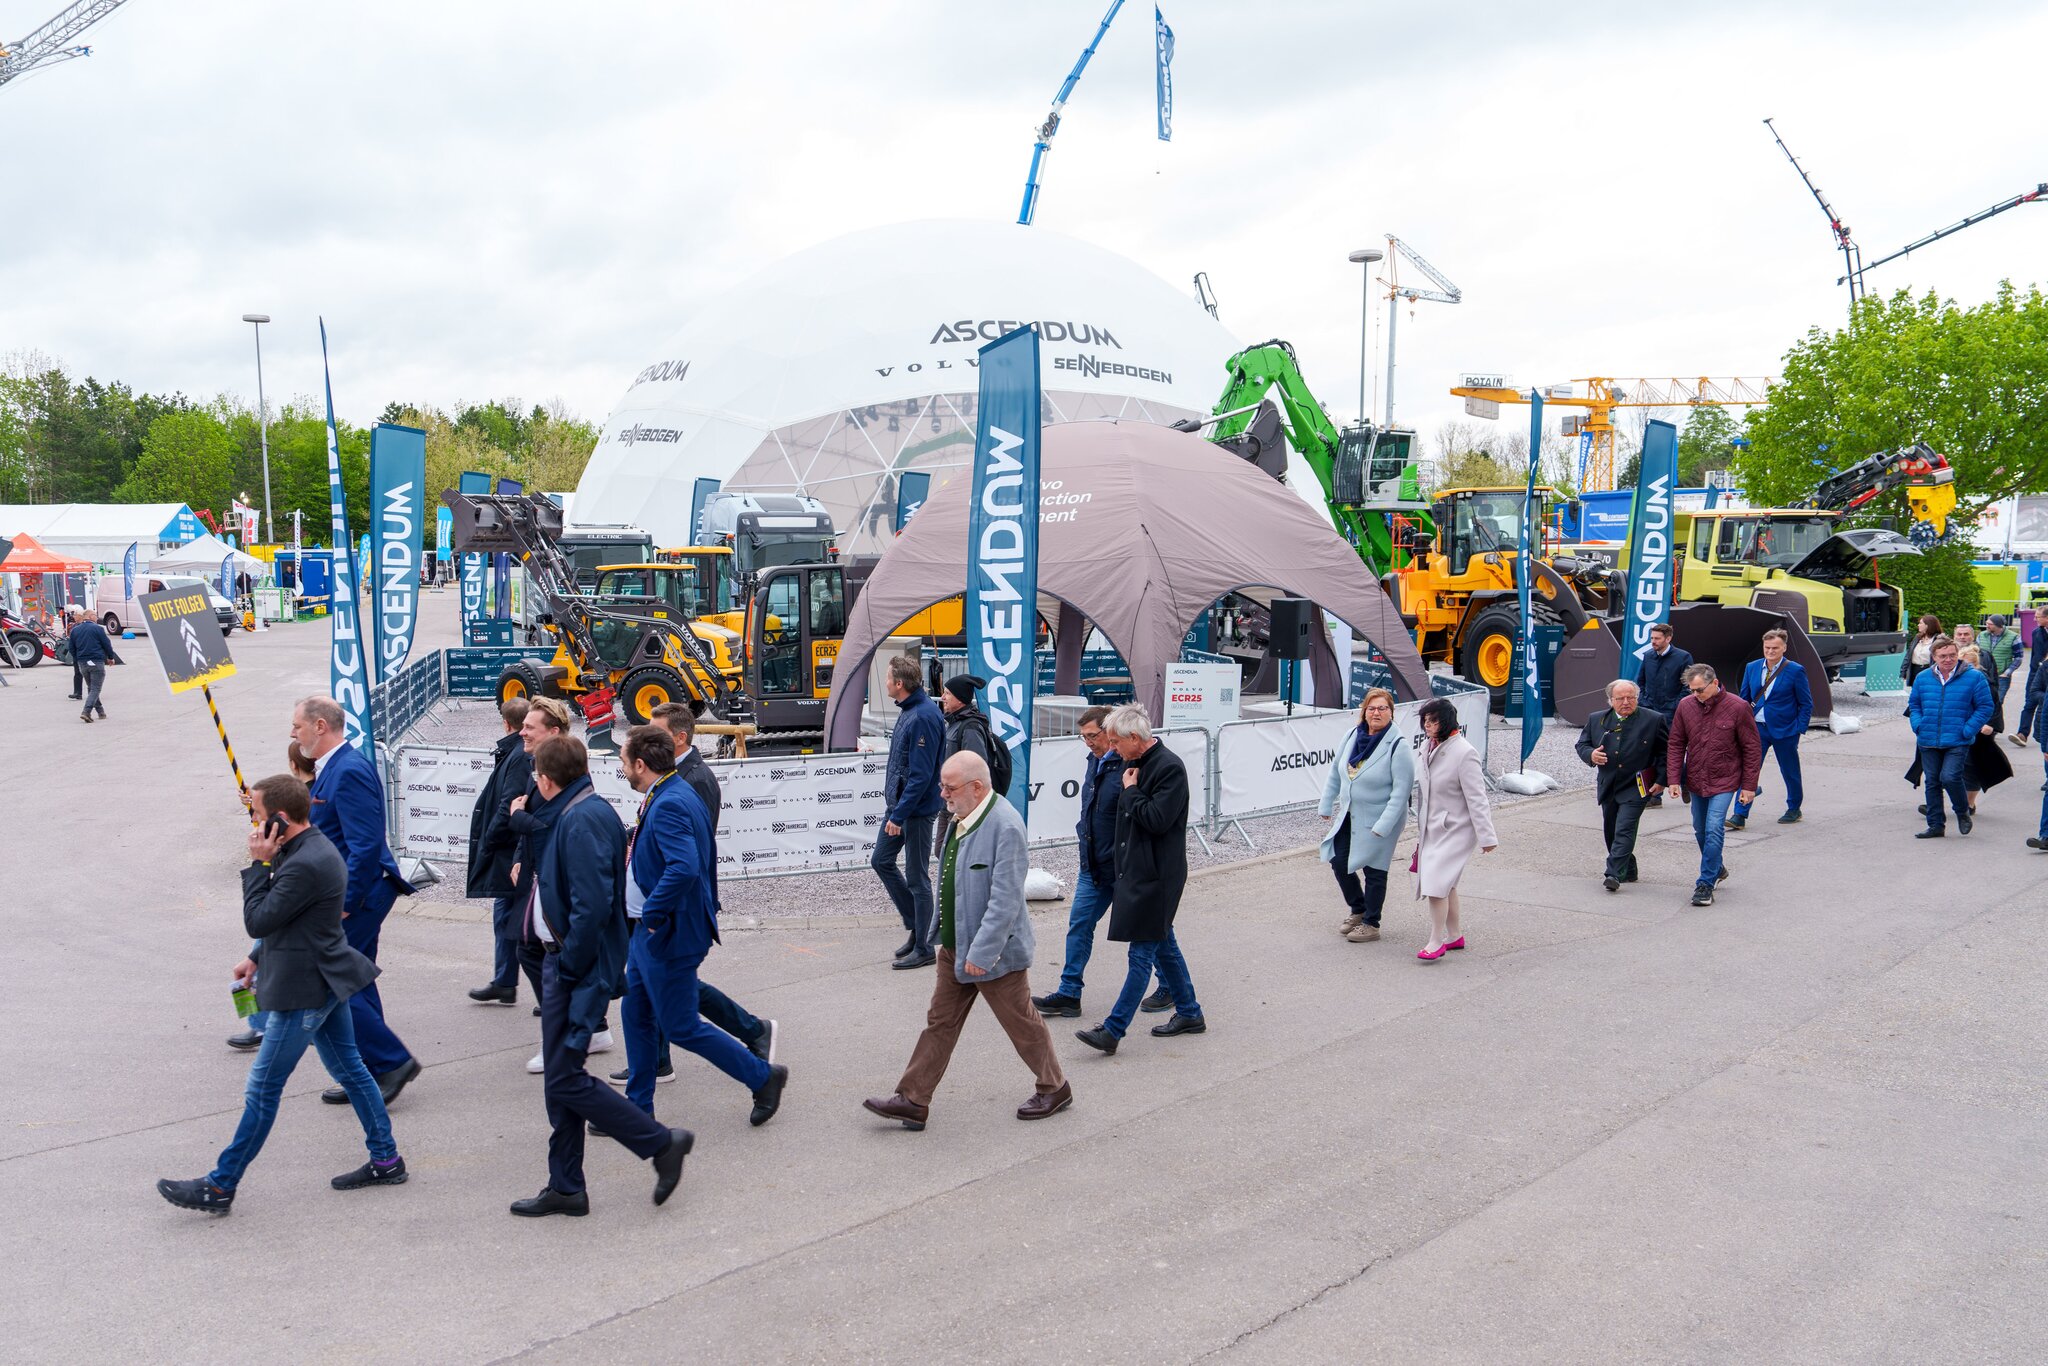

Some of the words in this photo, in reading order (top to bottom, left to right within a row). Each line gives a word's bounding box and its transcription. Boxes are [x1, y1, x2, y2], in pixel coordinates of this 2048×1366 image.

[875, 358, 981, 378] VOLV
[1054, 353, 1173, 384] SENNEBOGEN
[1465, 376, 1504, 387] POTAIN
[539, 575, 551, 600] VOL
[148, 598, 177, 621] BITTE
[175, 593, 207, 615] FOLGEN
[680, 624, 706, 661] VOLVO
[815, 646, 837, 657] ECR25
[1171, 694, 1202, 702] ECR25
[1271, 748, 1336, 772] ASCENDUM
[814, 767, 856, 777] ASCENDUM
[407, 783, 442, 793] ASCENDUM
[753, 798, 776, 806] FAHRERCLUB
[830, 792, 853, 800] FAHRERCLUB
[860, 790, 885, 799] ASCEN
[785, 822, 808, 830] FAHRERCLUB
[815, 818, 858, 829] ASCENDUM
[408, 834, 443, 844] ASCENDUM
[755, 851, 778, 859] FAHRERCLUB
[832, 844, 854, 852] FAHRERCLUB
